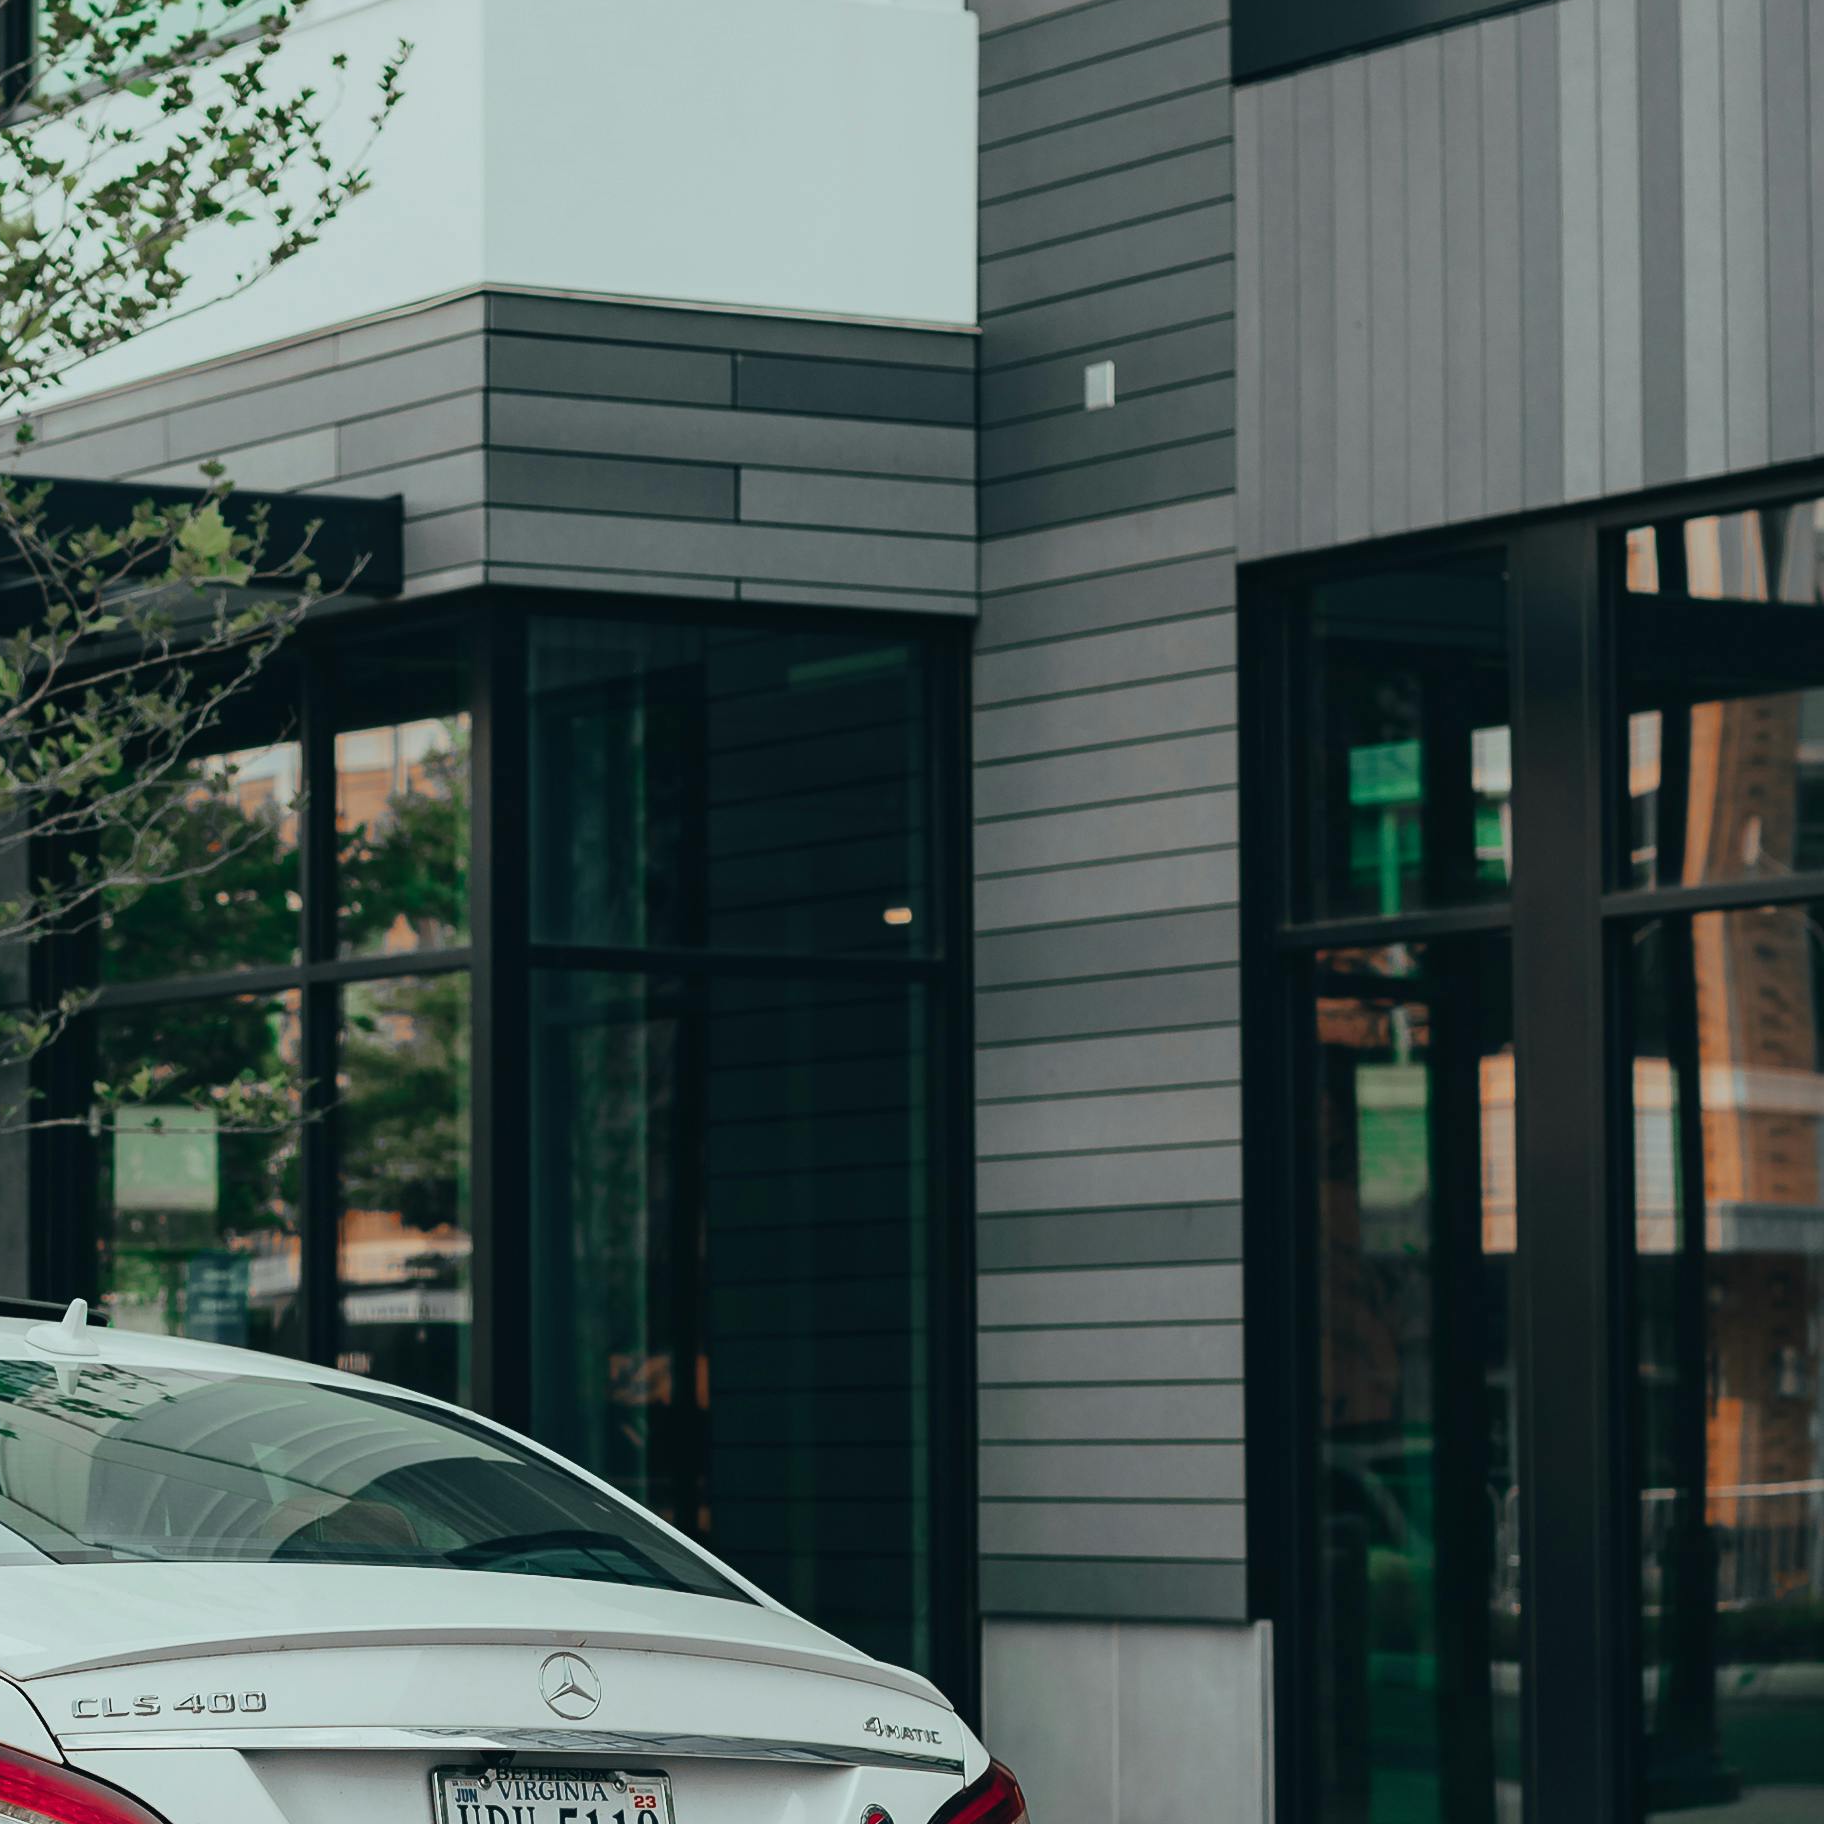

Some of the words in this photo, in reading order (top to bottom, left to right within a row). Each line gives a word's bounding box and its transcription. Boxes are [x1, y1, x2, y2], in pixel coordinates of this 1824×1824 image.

[71, 1695, 161, 1719] CLS
[172, 1691, 267, 1714] 400
[863, 1716, 942, 1745] 4MATIC
[455, 1788, 479, 1803] JUN
[497, 1780, 609, 1802] VIRGINIA
[633, 1795, 657, 1808] 23
